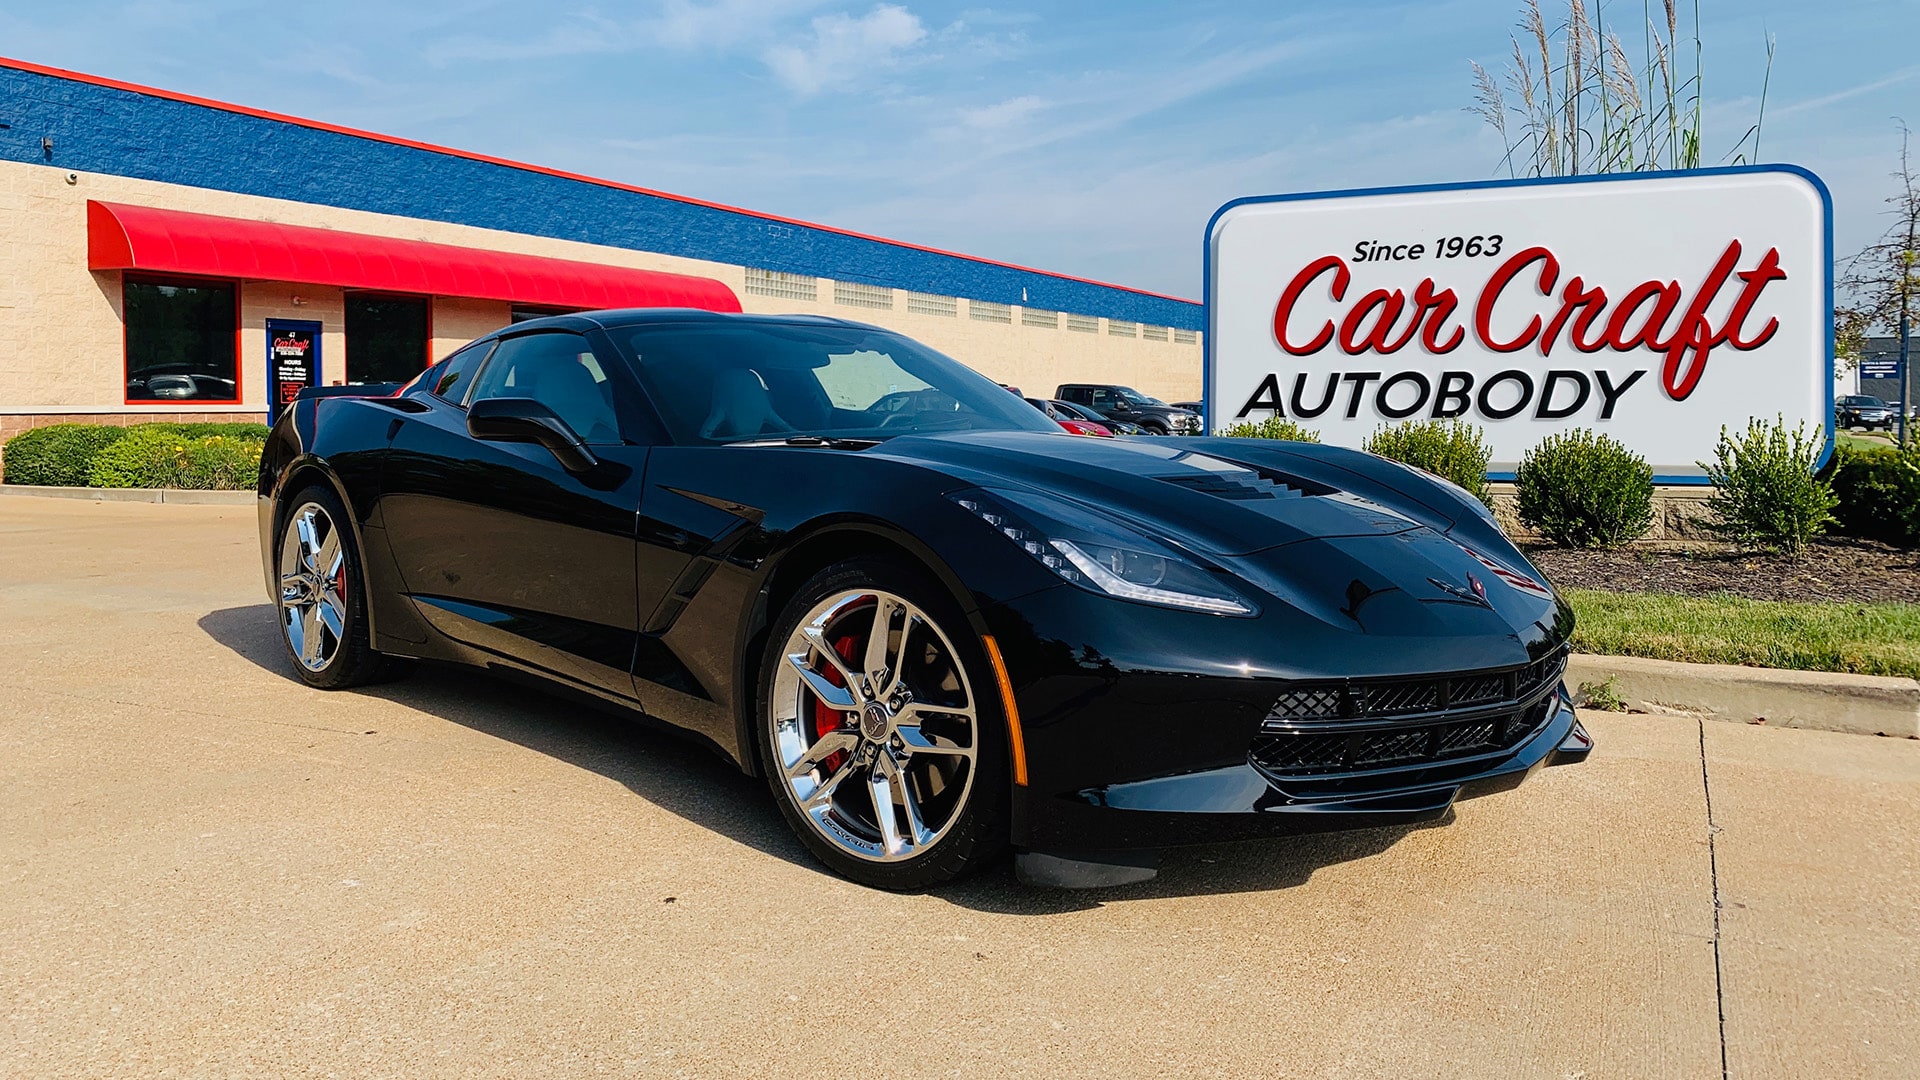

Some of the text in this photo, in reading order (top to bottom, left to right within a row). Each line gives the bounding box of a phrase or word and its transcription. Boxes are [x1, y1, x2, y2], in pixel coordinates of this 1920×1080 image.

[1352, 235, 1503, 263] Since 1963
[1236, 369, 1647, 421] AUTOBODY
